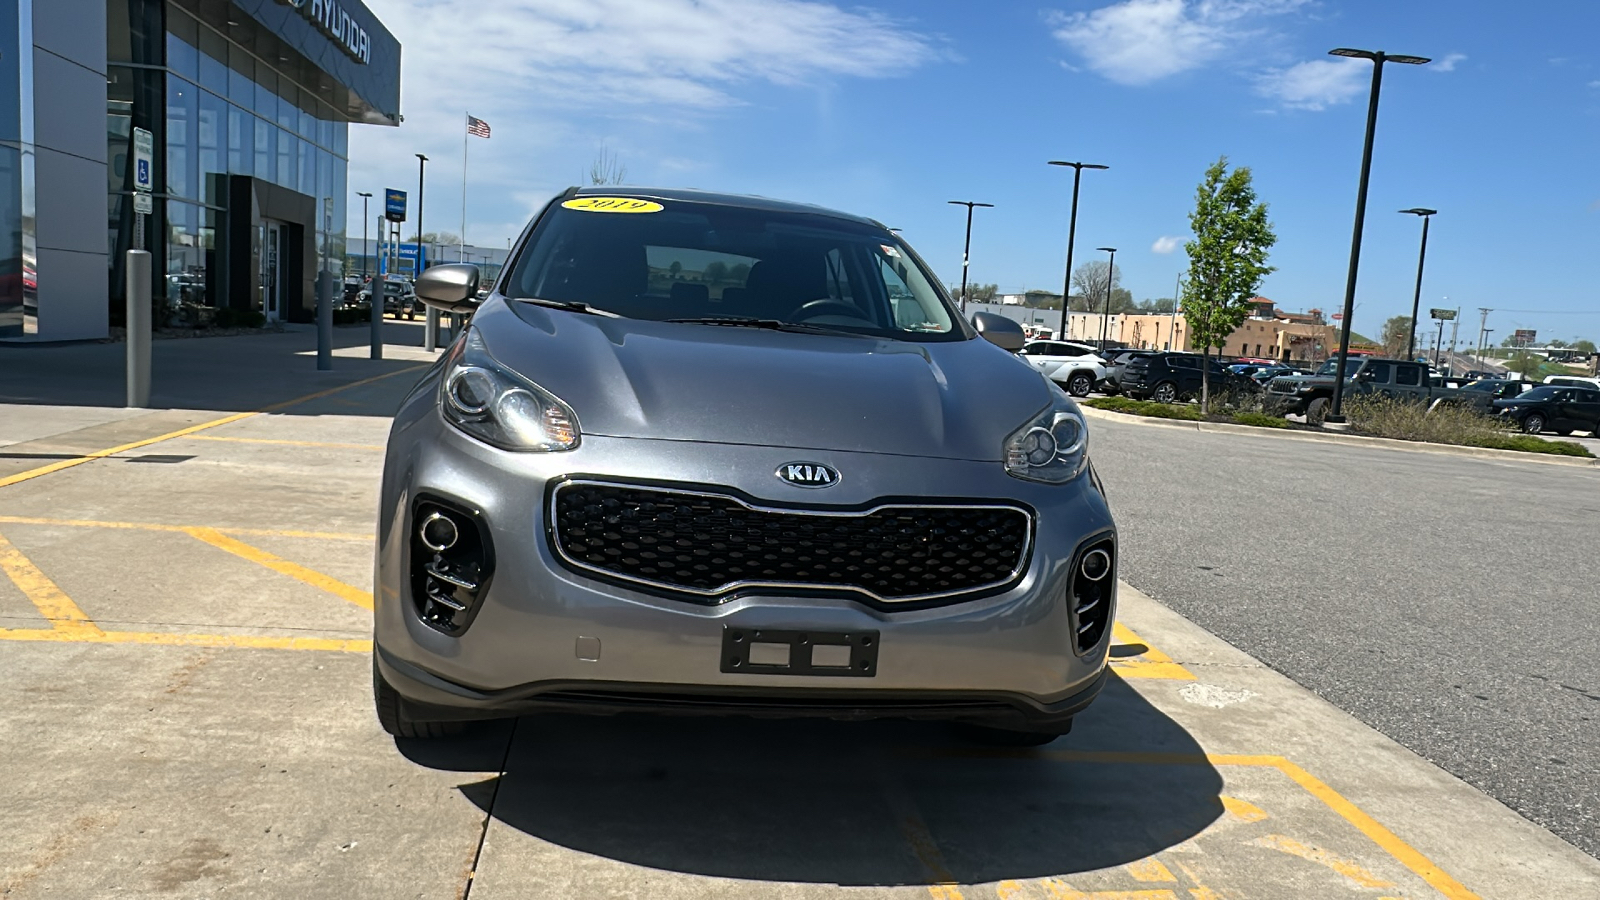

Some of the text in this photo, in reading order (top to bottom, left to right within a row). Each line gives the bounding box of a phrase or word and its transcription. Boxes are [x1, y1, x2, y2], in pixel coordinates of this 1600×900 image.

[311, 0, 370, 65] HYUNDAI
[577, 199, 648, 209] 2019
[787, 465, 831, 482] KIA
